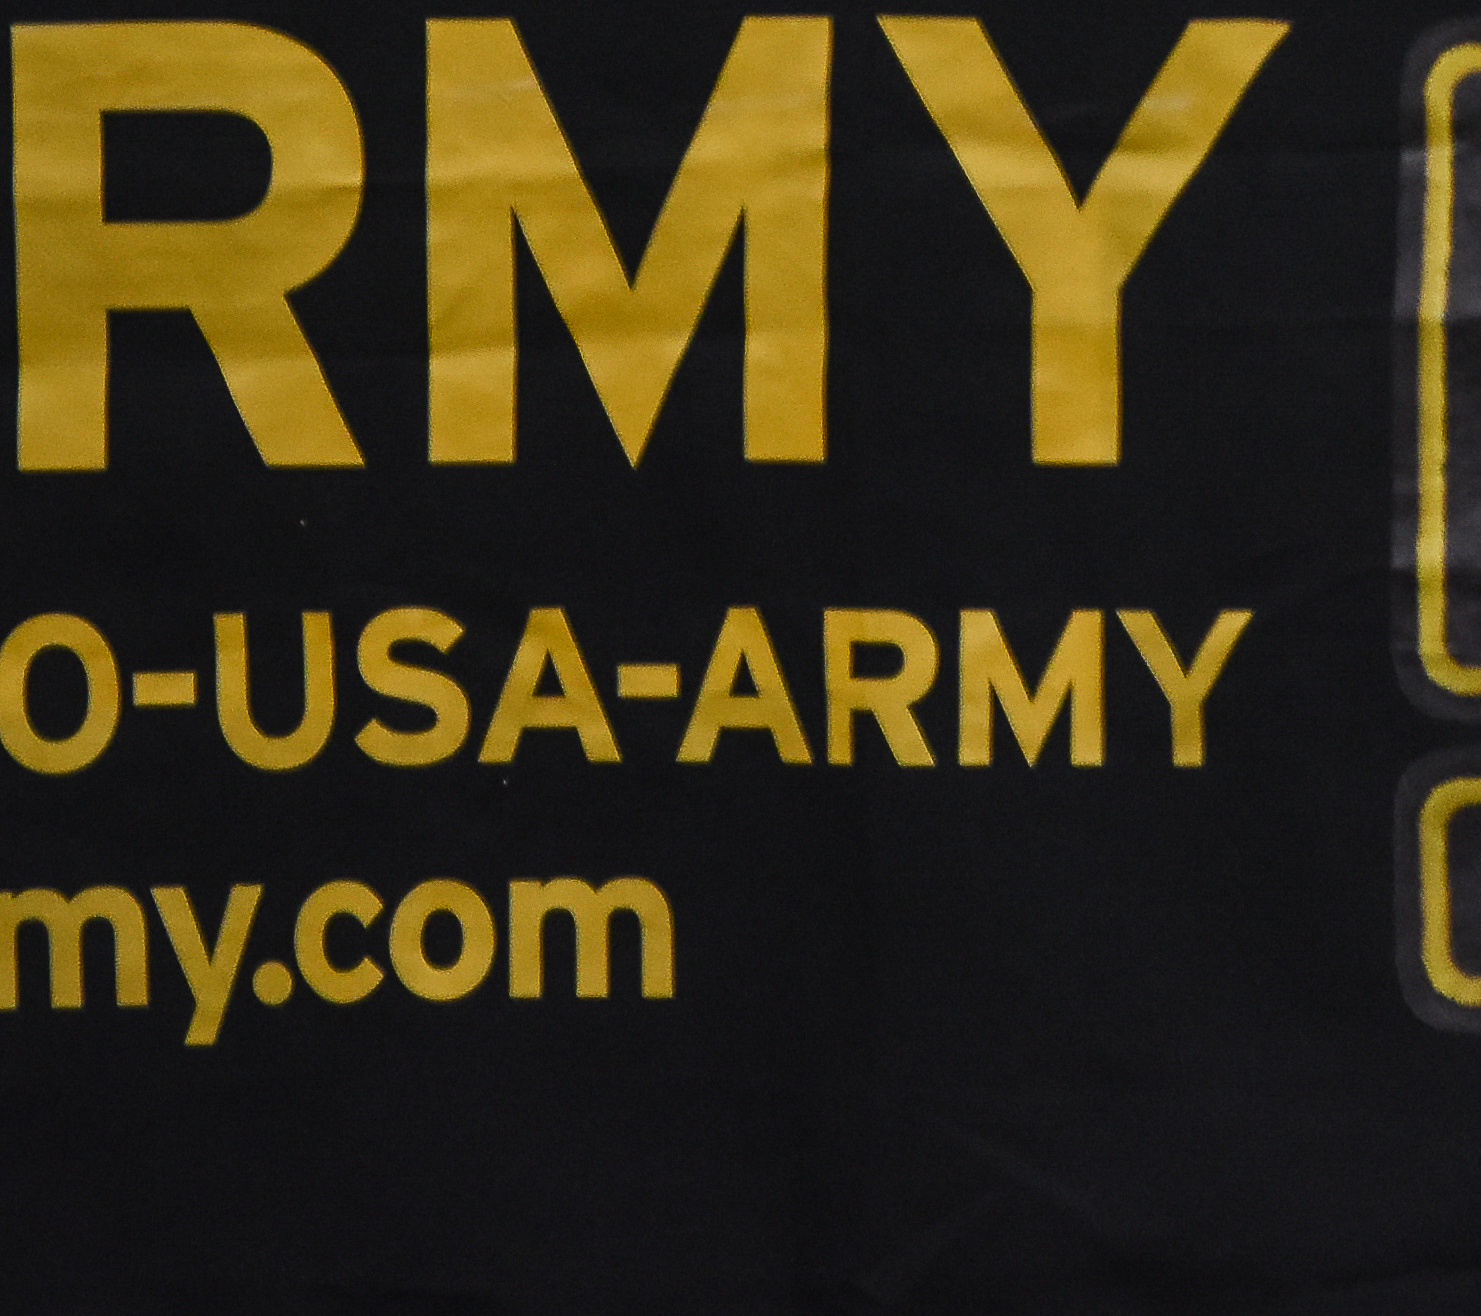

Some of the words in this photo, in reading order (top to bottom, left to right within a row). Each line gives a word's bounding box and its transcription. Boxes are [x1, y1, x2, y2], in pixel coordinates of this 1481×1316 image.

[11, 14, 1292, 473] RMY
[0, 605, 1253, 774] O-USA-ARMY
[0, 874, 675, 1045] my.com
